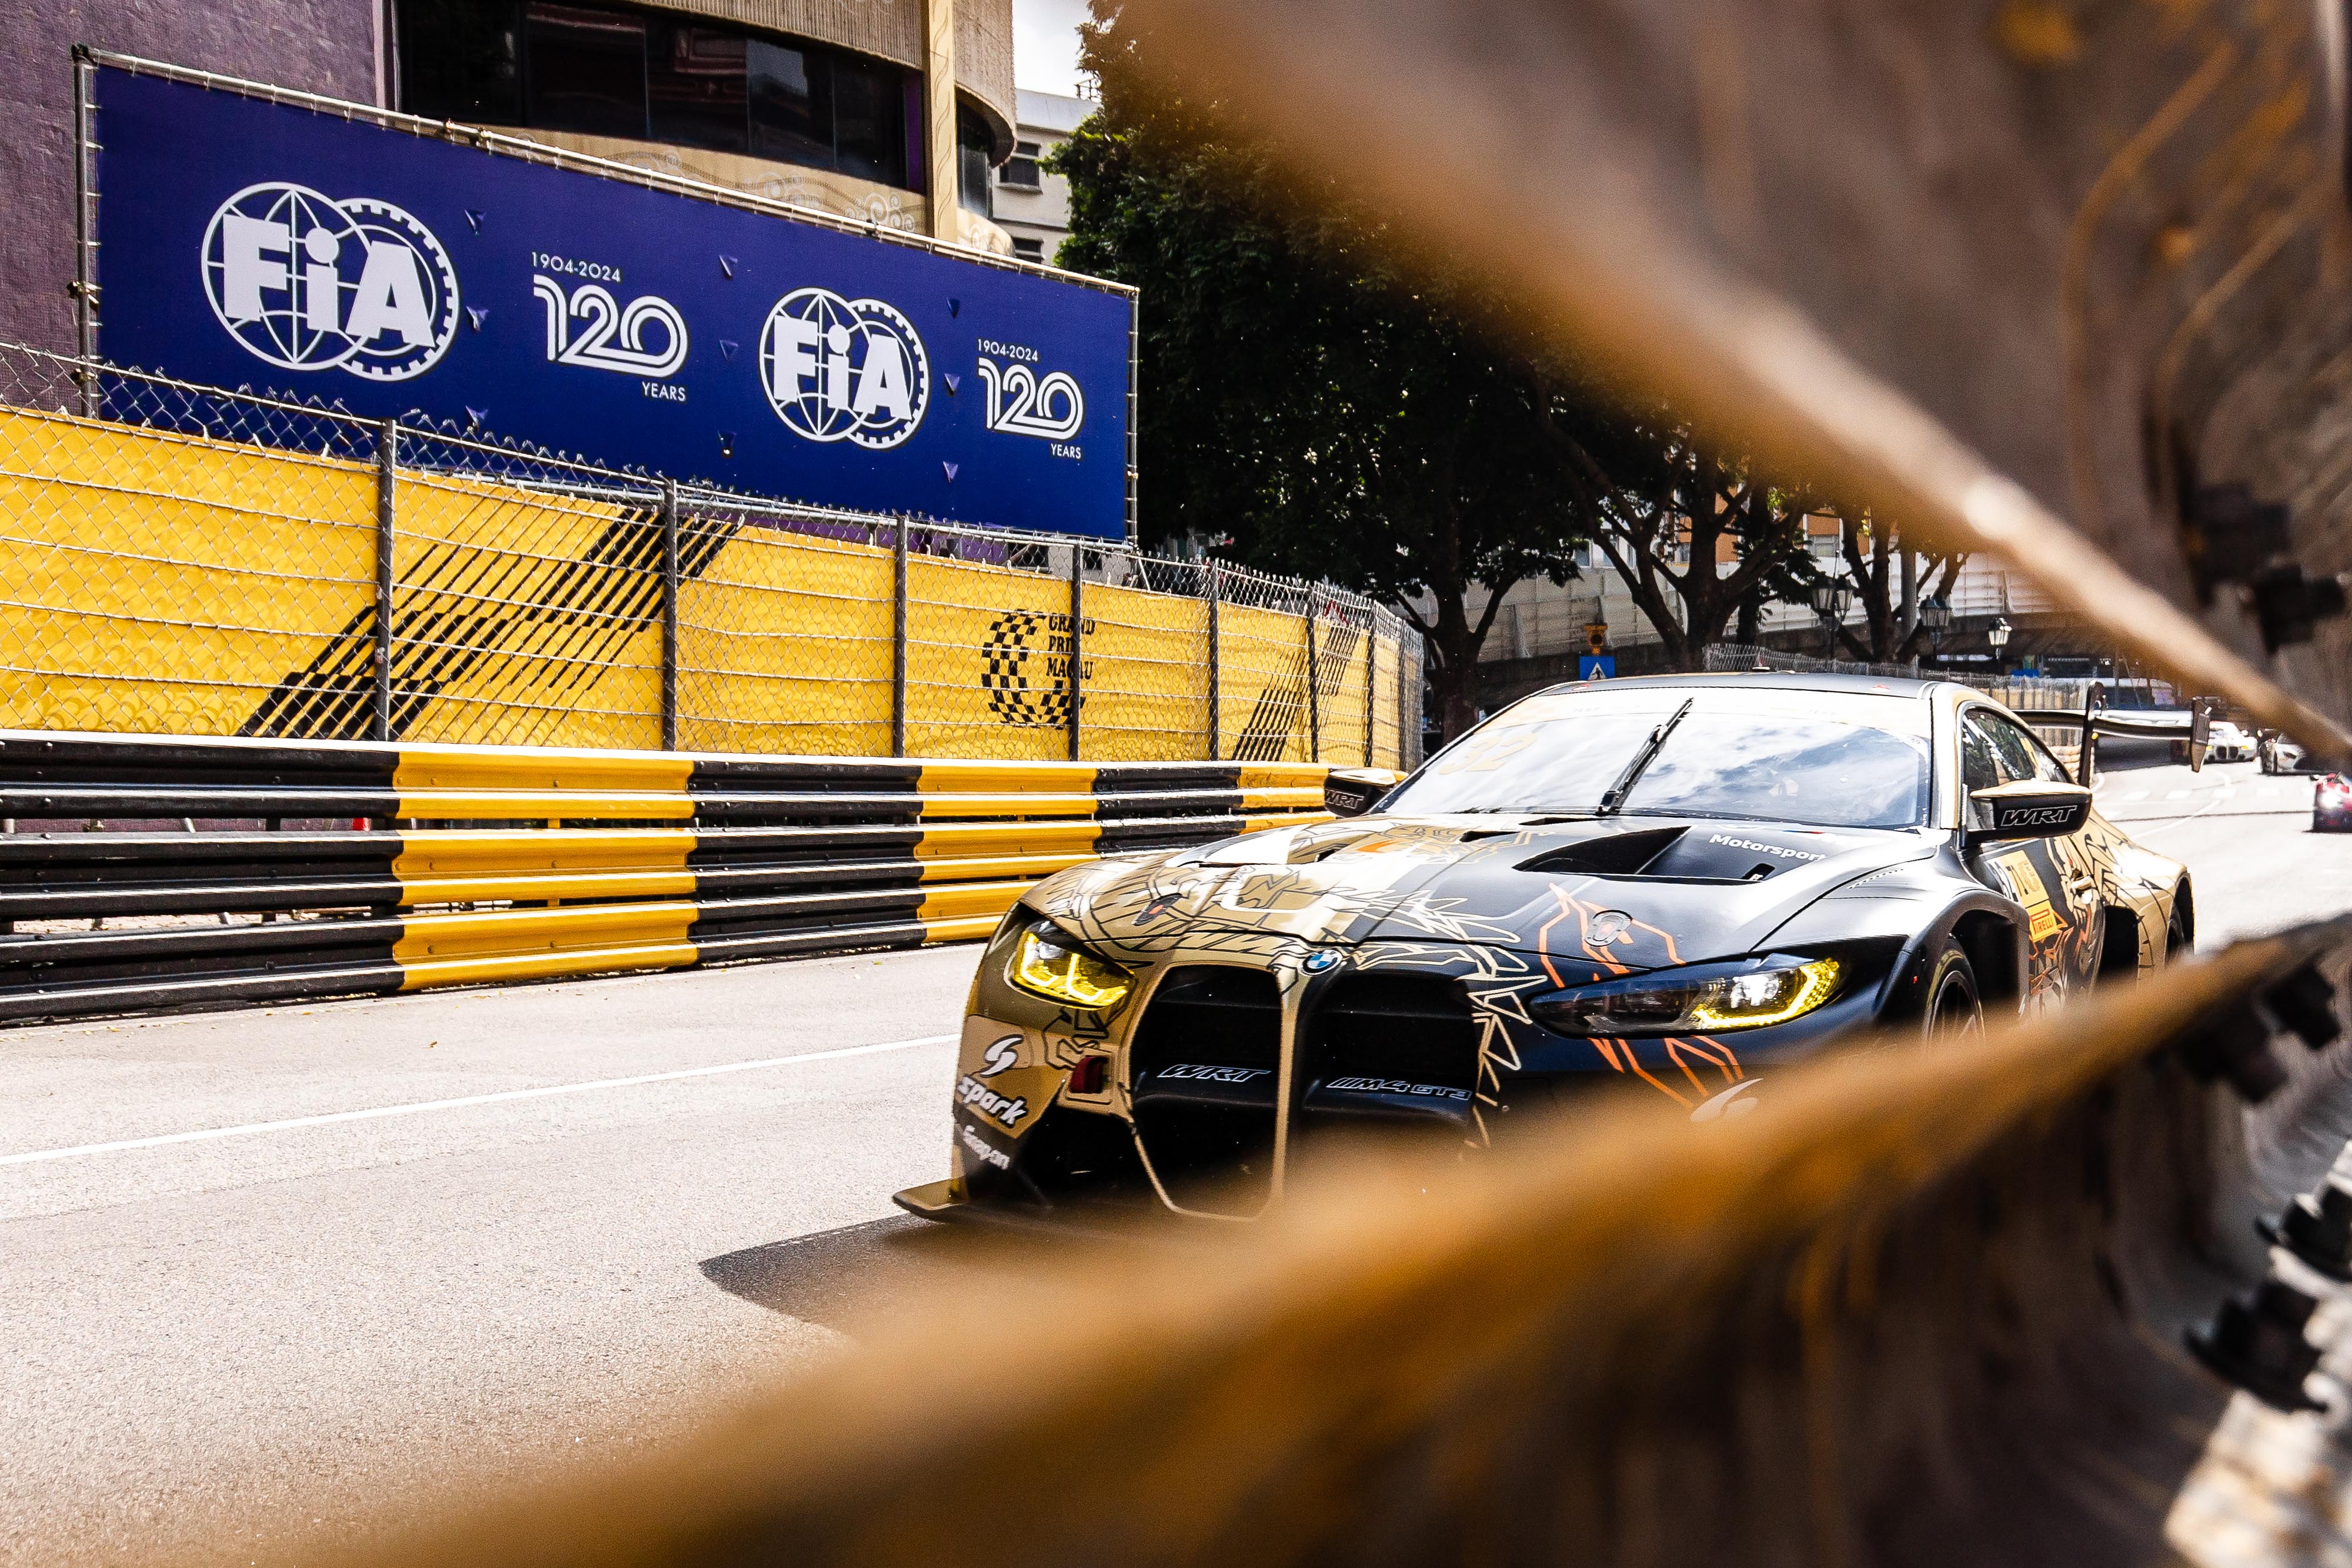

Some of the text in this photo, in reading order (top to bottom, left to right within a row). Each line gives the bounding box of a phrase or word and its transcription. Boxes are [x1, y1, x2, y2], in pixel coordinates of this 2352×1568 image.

[532, 251, 621, 282] 1904-2024
[533, 274, 688, 377] 120
[978, 339, 1038, 362] 1904-2024
[642, 381, 686, 402] YEARS
[978, 357, 1083, 440] 120
[1051, 443, 1081, 459] YEARS
[1048, 635, 1074, 654] PRI
[2000, 805, 2078, 827] WRT
[1709, 834, 1827, 861] Motorsport
[2029, 908, 2053, 935] PIRELLI
[1157, 1064, 1272, 1082] WRT
[1410, 1084, 1472, 1101] GT3
